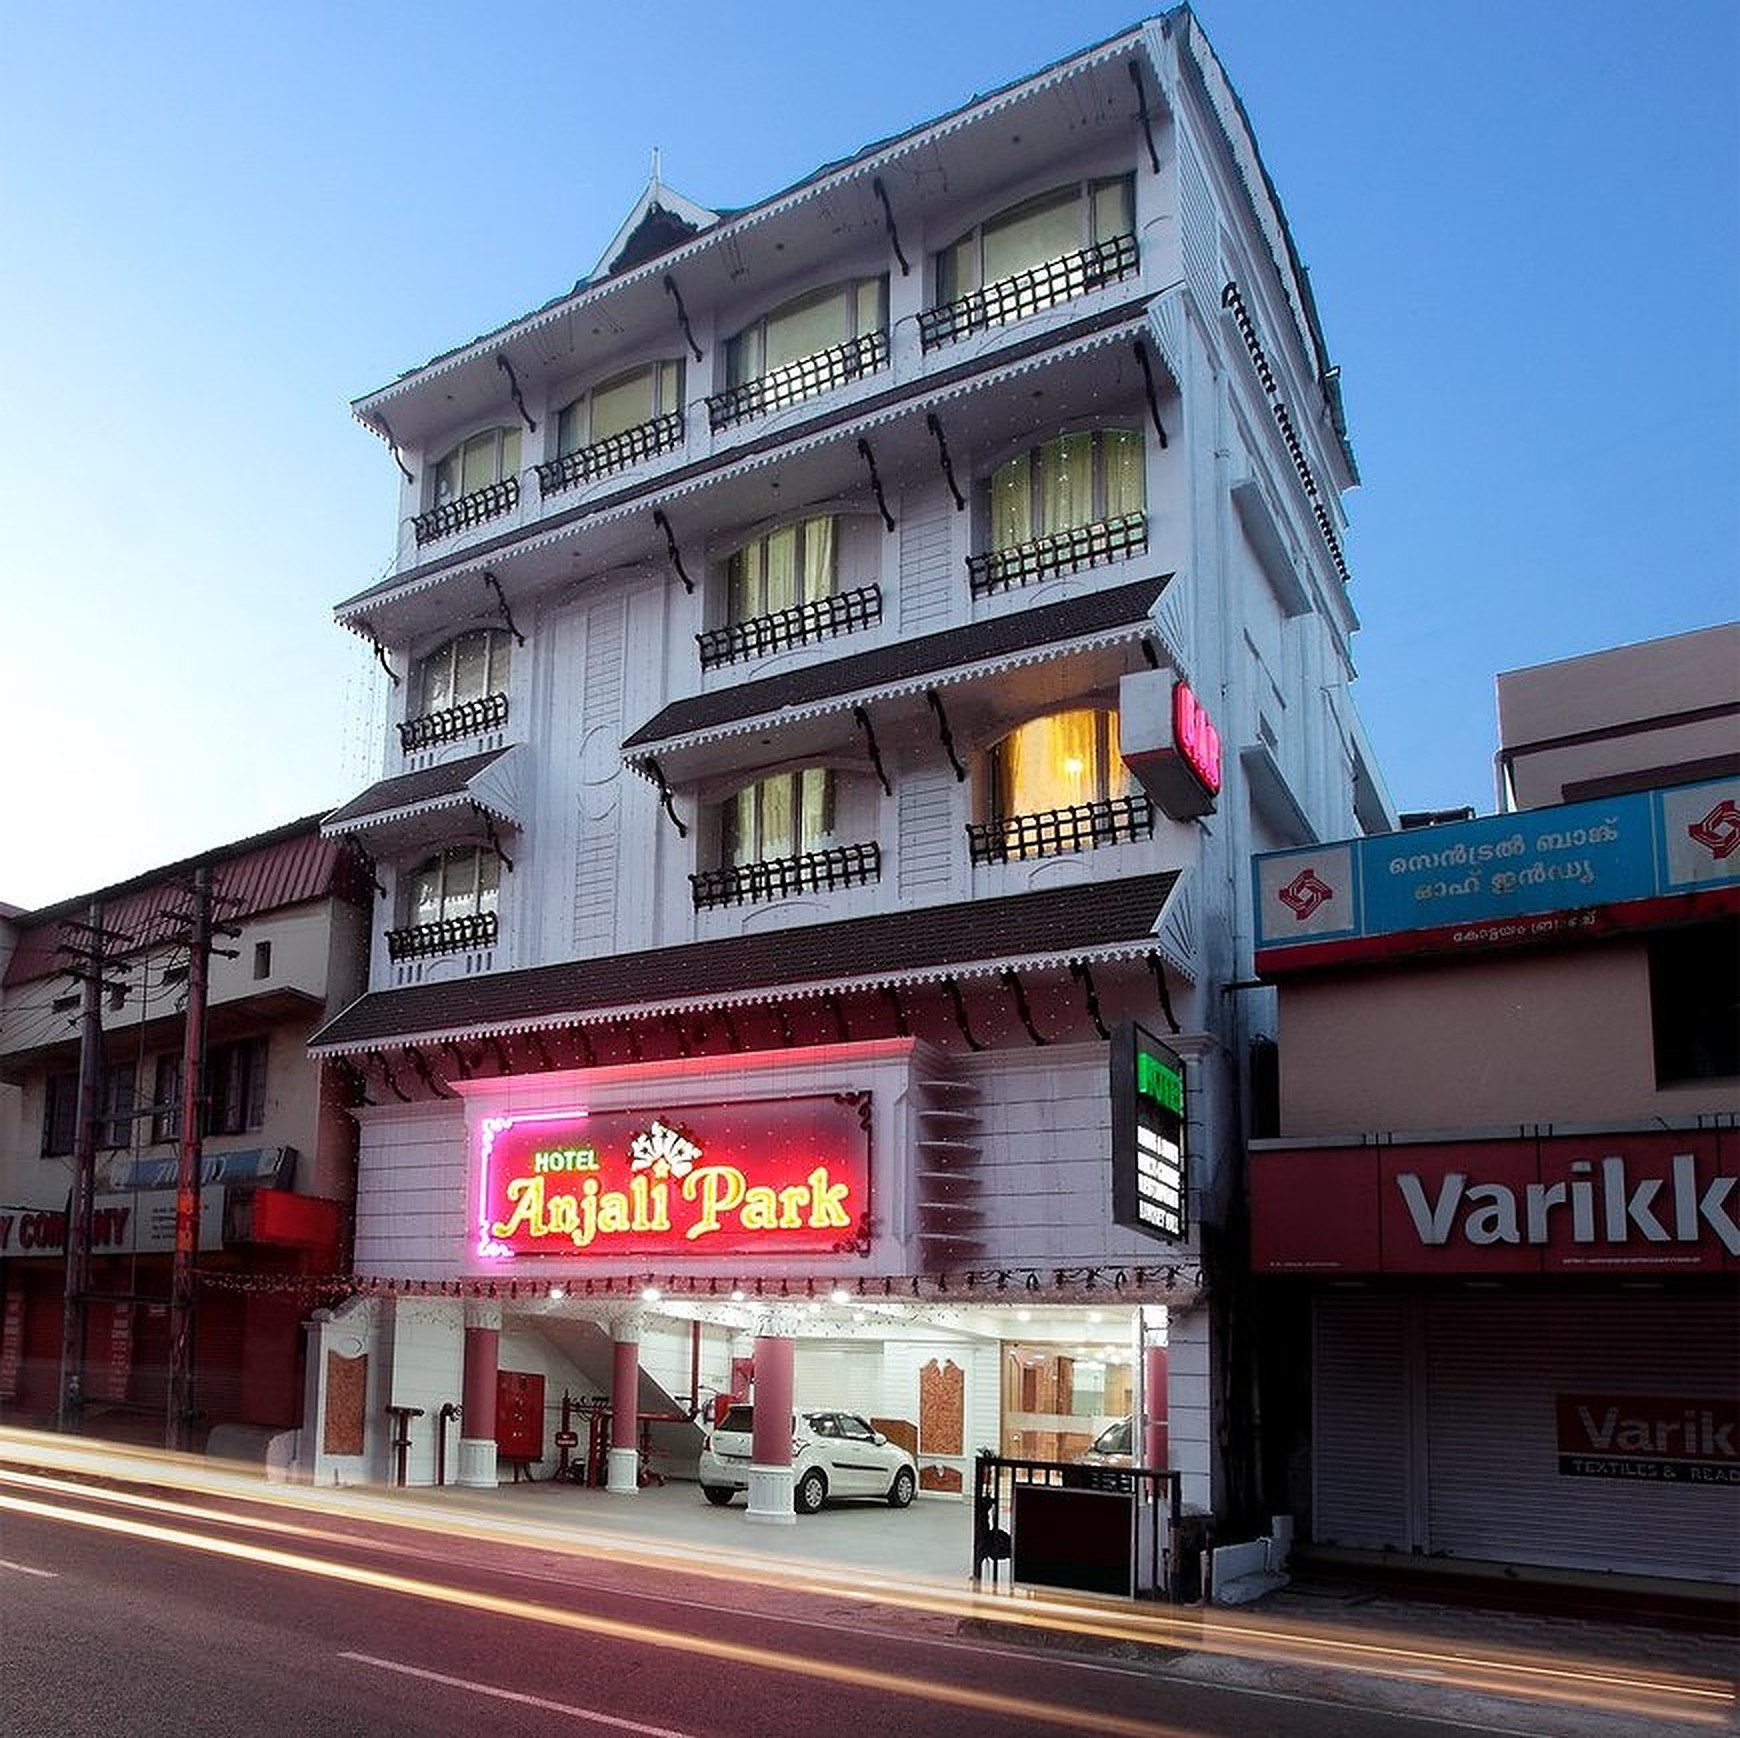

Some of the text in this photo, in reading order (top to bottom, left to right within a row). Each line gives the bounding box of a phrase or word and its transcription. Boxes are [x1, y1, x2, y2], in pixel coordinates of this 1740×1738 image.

[533, 1148, 600, 1174] HOTEL
[492, 1158, 852, 1247] Anjali Park
[20, 1208, 130, 1249] COMNY
[1570, 1458, 1659, 1478] TEXTILES
[1663, 1465, 1678, 1480] &
